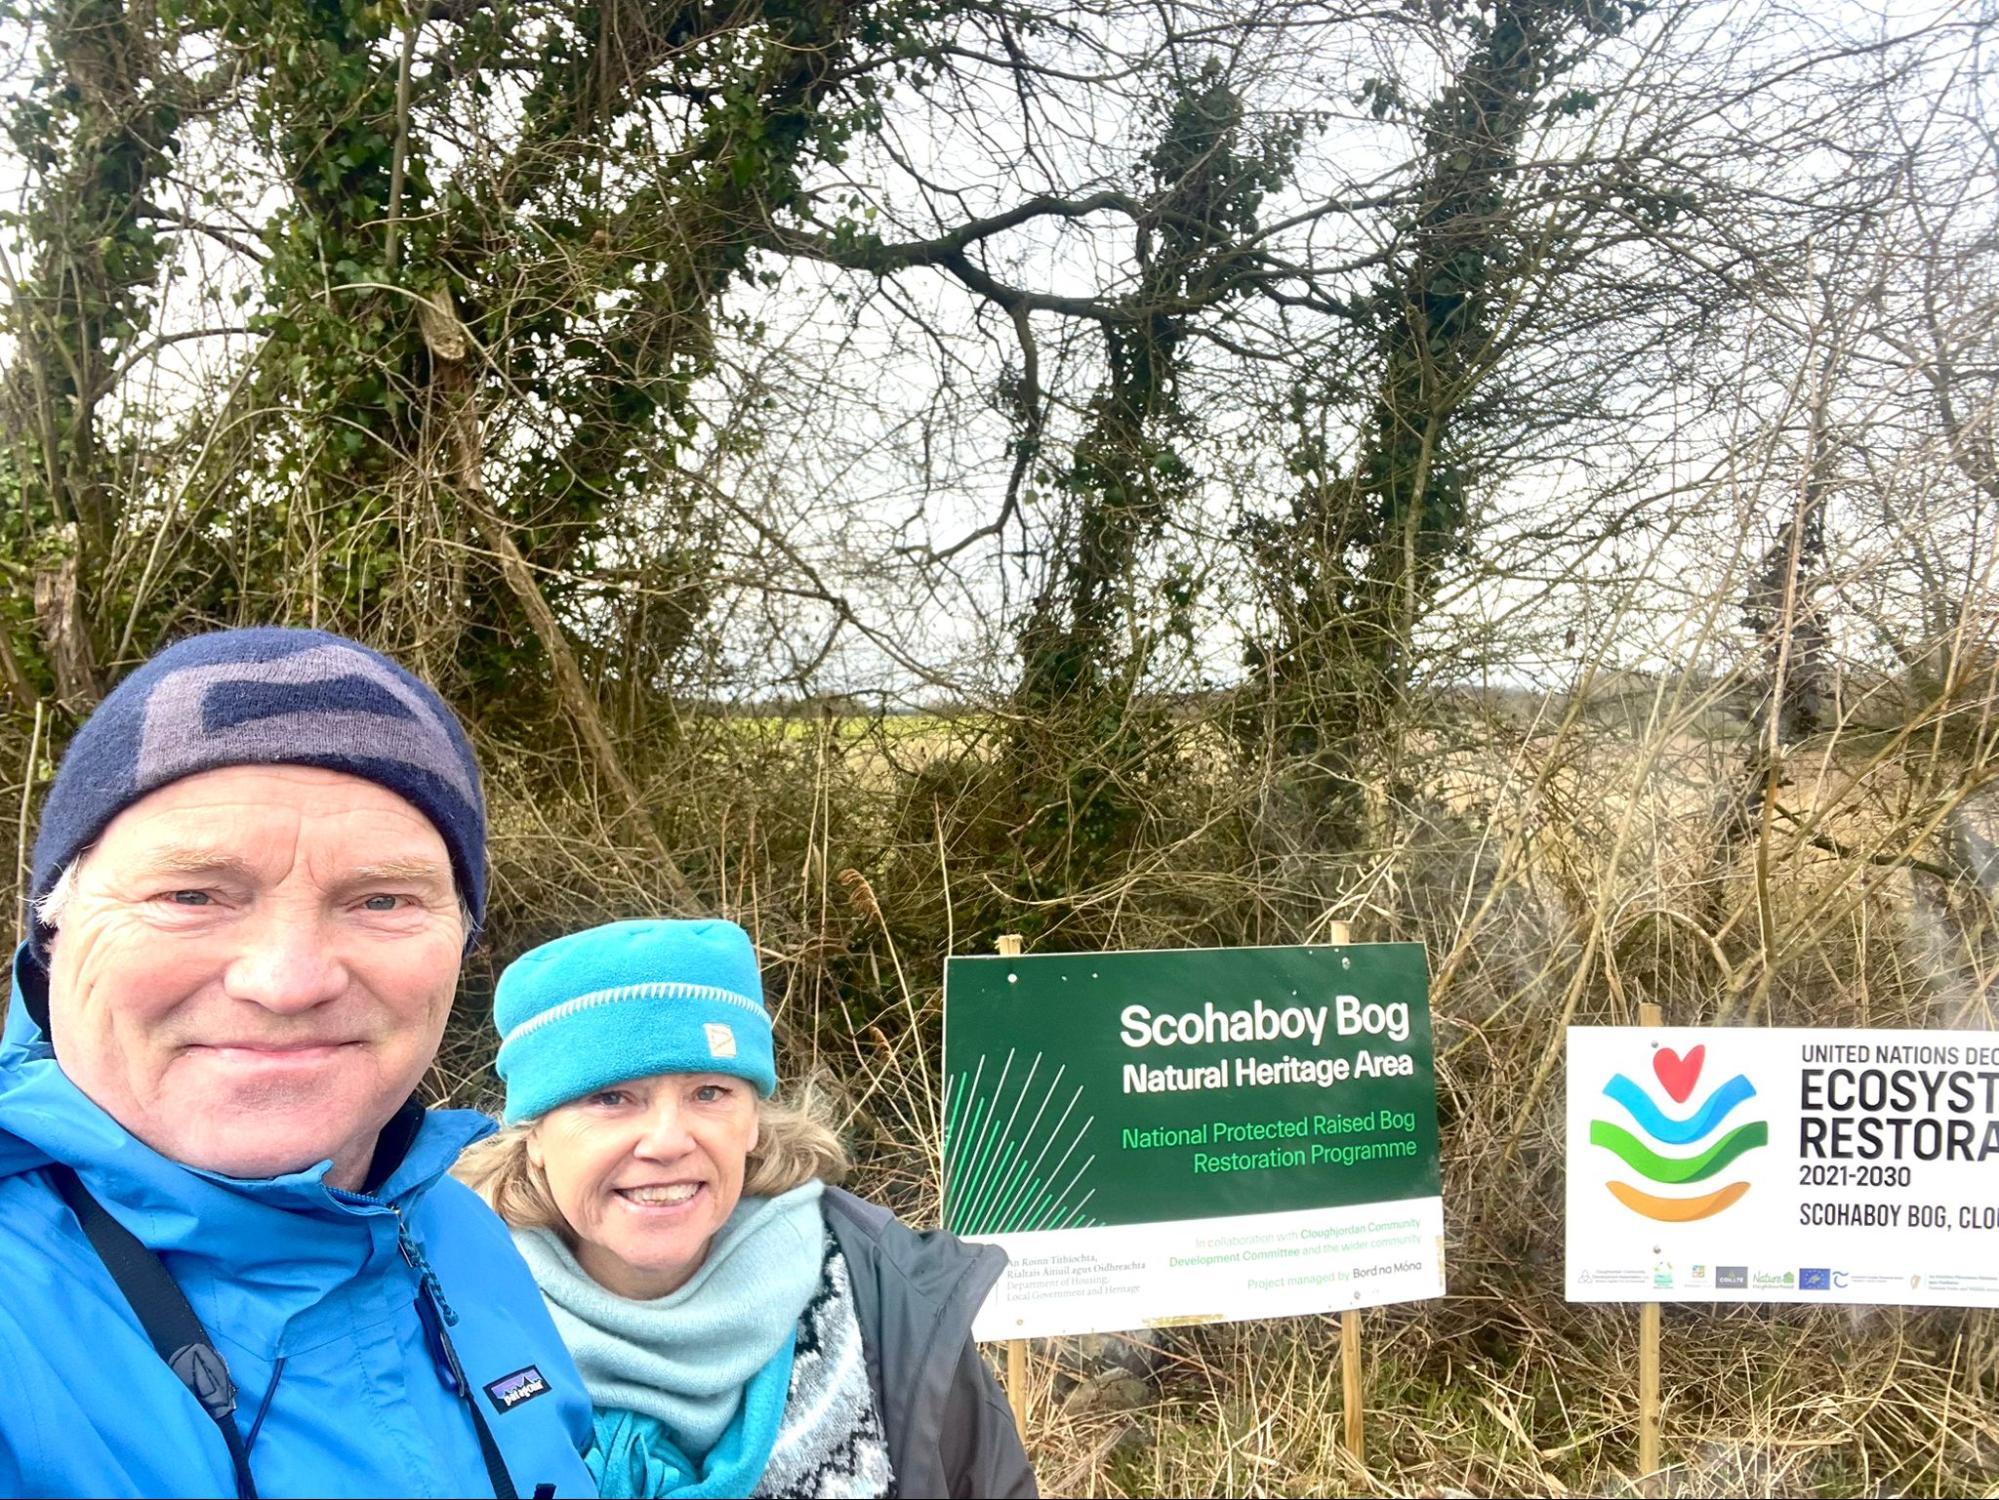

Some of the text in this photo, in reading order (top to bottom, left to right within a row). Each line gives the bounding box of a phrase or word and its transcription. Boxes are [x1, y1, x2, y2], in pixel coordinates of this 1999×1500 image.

[1120, 995, 1410, 1047] Scohaboy Bog
[1802, 1044, 1870, 1063] UNITED
[1876, 1045, 1959, 1065] NATIONS
[1122, 1050, 1414, 1094] Natural Heritage Area
[1801, 1068, 1999, 1114] ECOSYST
[1122, 1109, 1416, 1149] National Protected Raised Bog
[1799, 1116, 1999, 1162] RESTORA
[1194, 1140, 1418, 1173] Restoration Programme
[1799, 1165, 1912, 1187] 2021-2030
[1207, 1233, 1274, 1248] collaboration
[1276, 1231, 1299, 1243] with
[1301, 1224, 1366, 1240] Cloughjordan
[1368, 1218, 1421, 1233] Community
[1799, 1203, 1999, 1232] SCOHABOY BOG, CLO
[1169, 1234, 1421, 1268] Development Committee and the wider community
[1007, 1291, 1031, 1302] Local
[1031, 1288, 1085, 1300] Government
[1087, 1285, 1103, 1296] and
[1247, 1277, 1285, 1291] Project
[1287, 1271, 1336, 1286] managed
[1338, 1271, 1350, 1282] by
[1353, 1265, 1378, 1279] Bord
[1379, 1265, 1392, 1275] na
